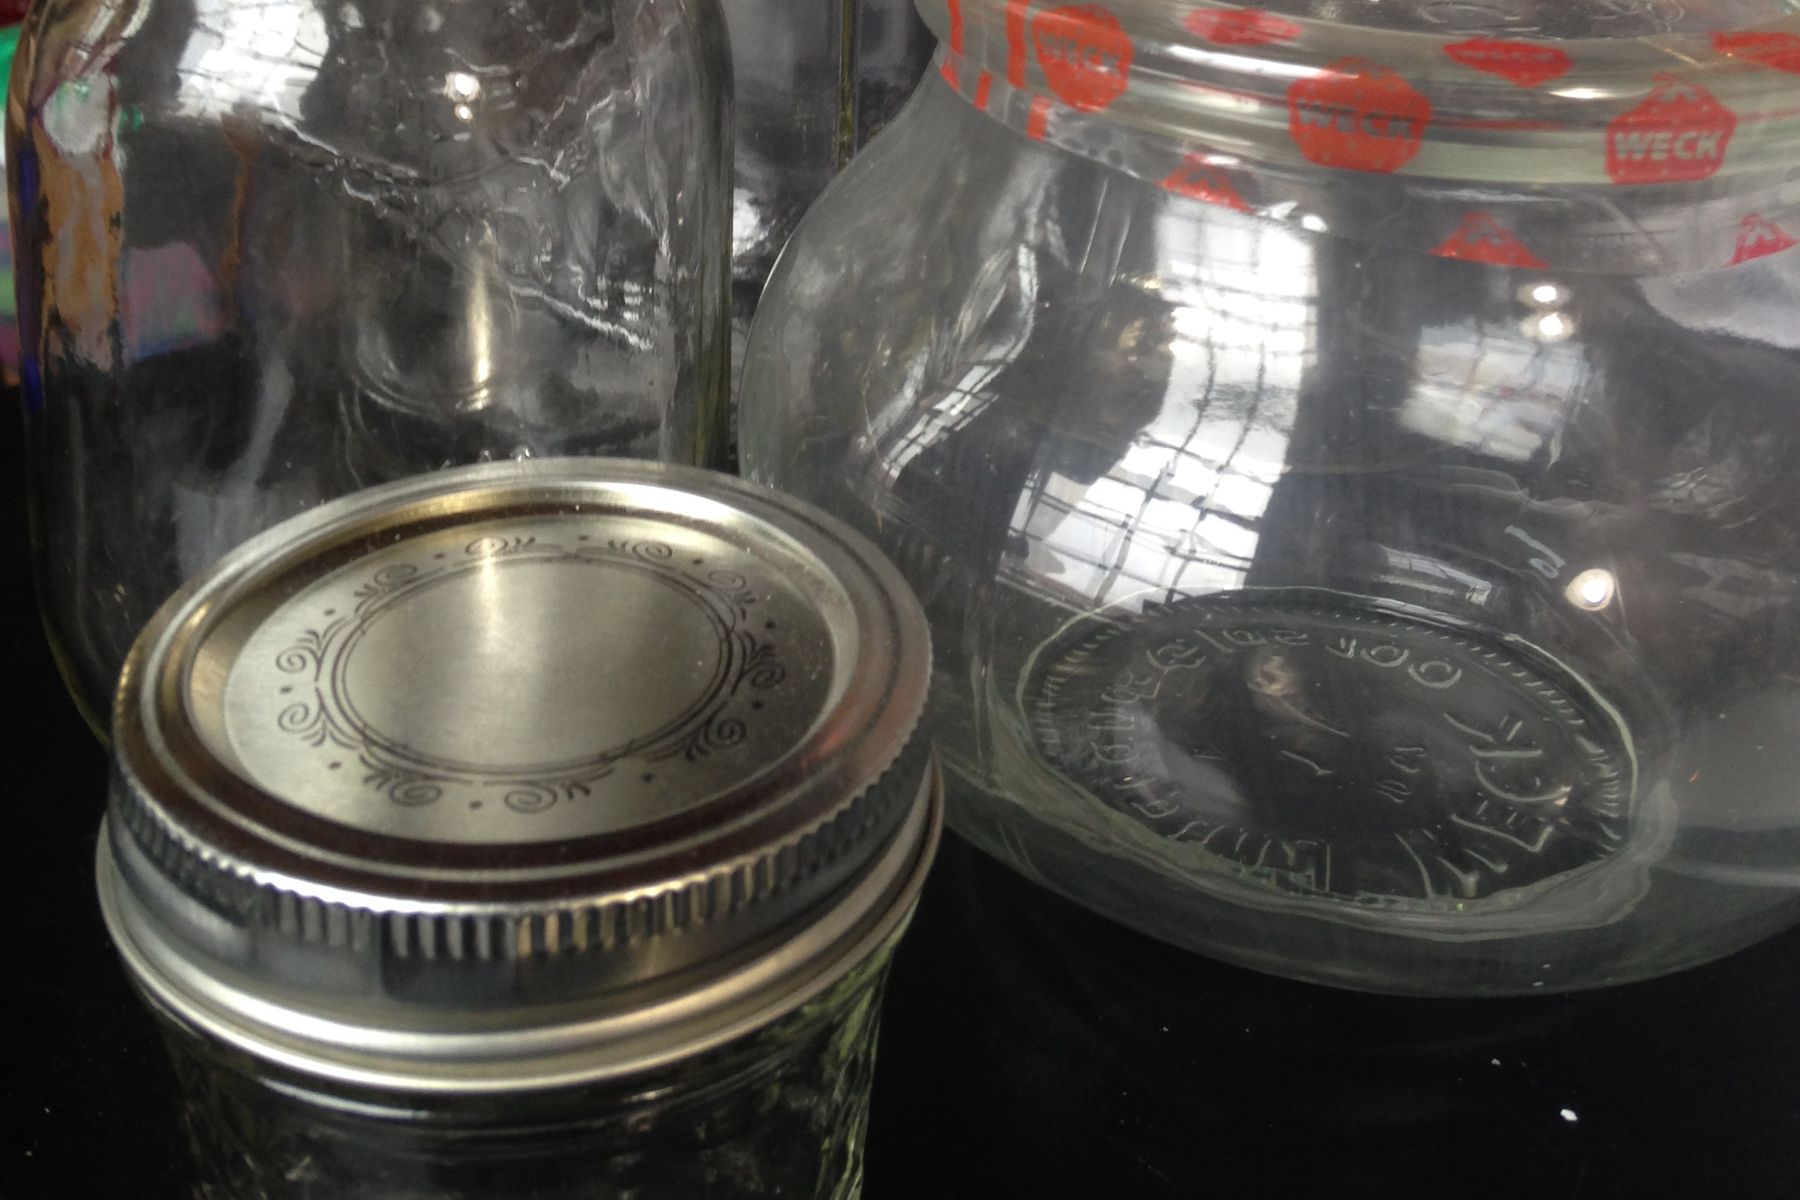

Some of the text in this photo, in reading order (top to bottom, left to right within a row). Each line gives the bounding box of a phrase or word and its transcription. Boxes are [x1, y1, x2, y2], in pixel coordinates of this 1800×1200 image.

[1038, 29, 1120, 79] WECK
[1296, 98, 1413, 143] WECK
[1614, 130, 1723, 161] WECK
